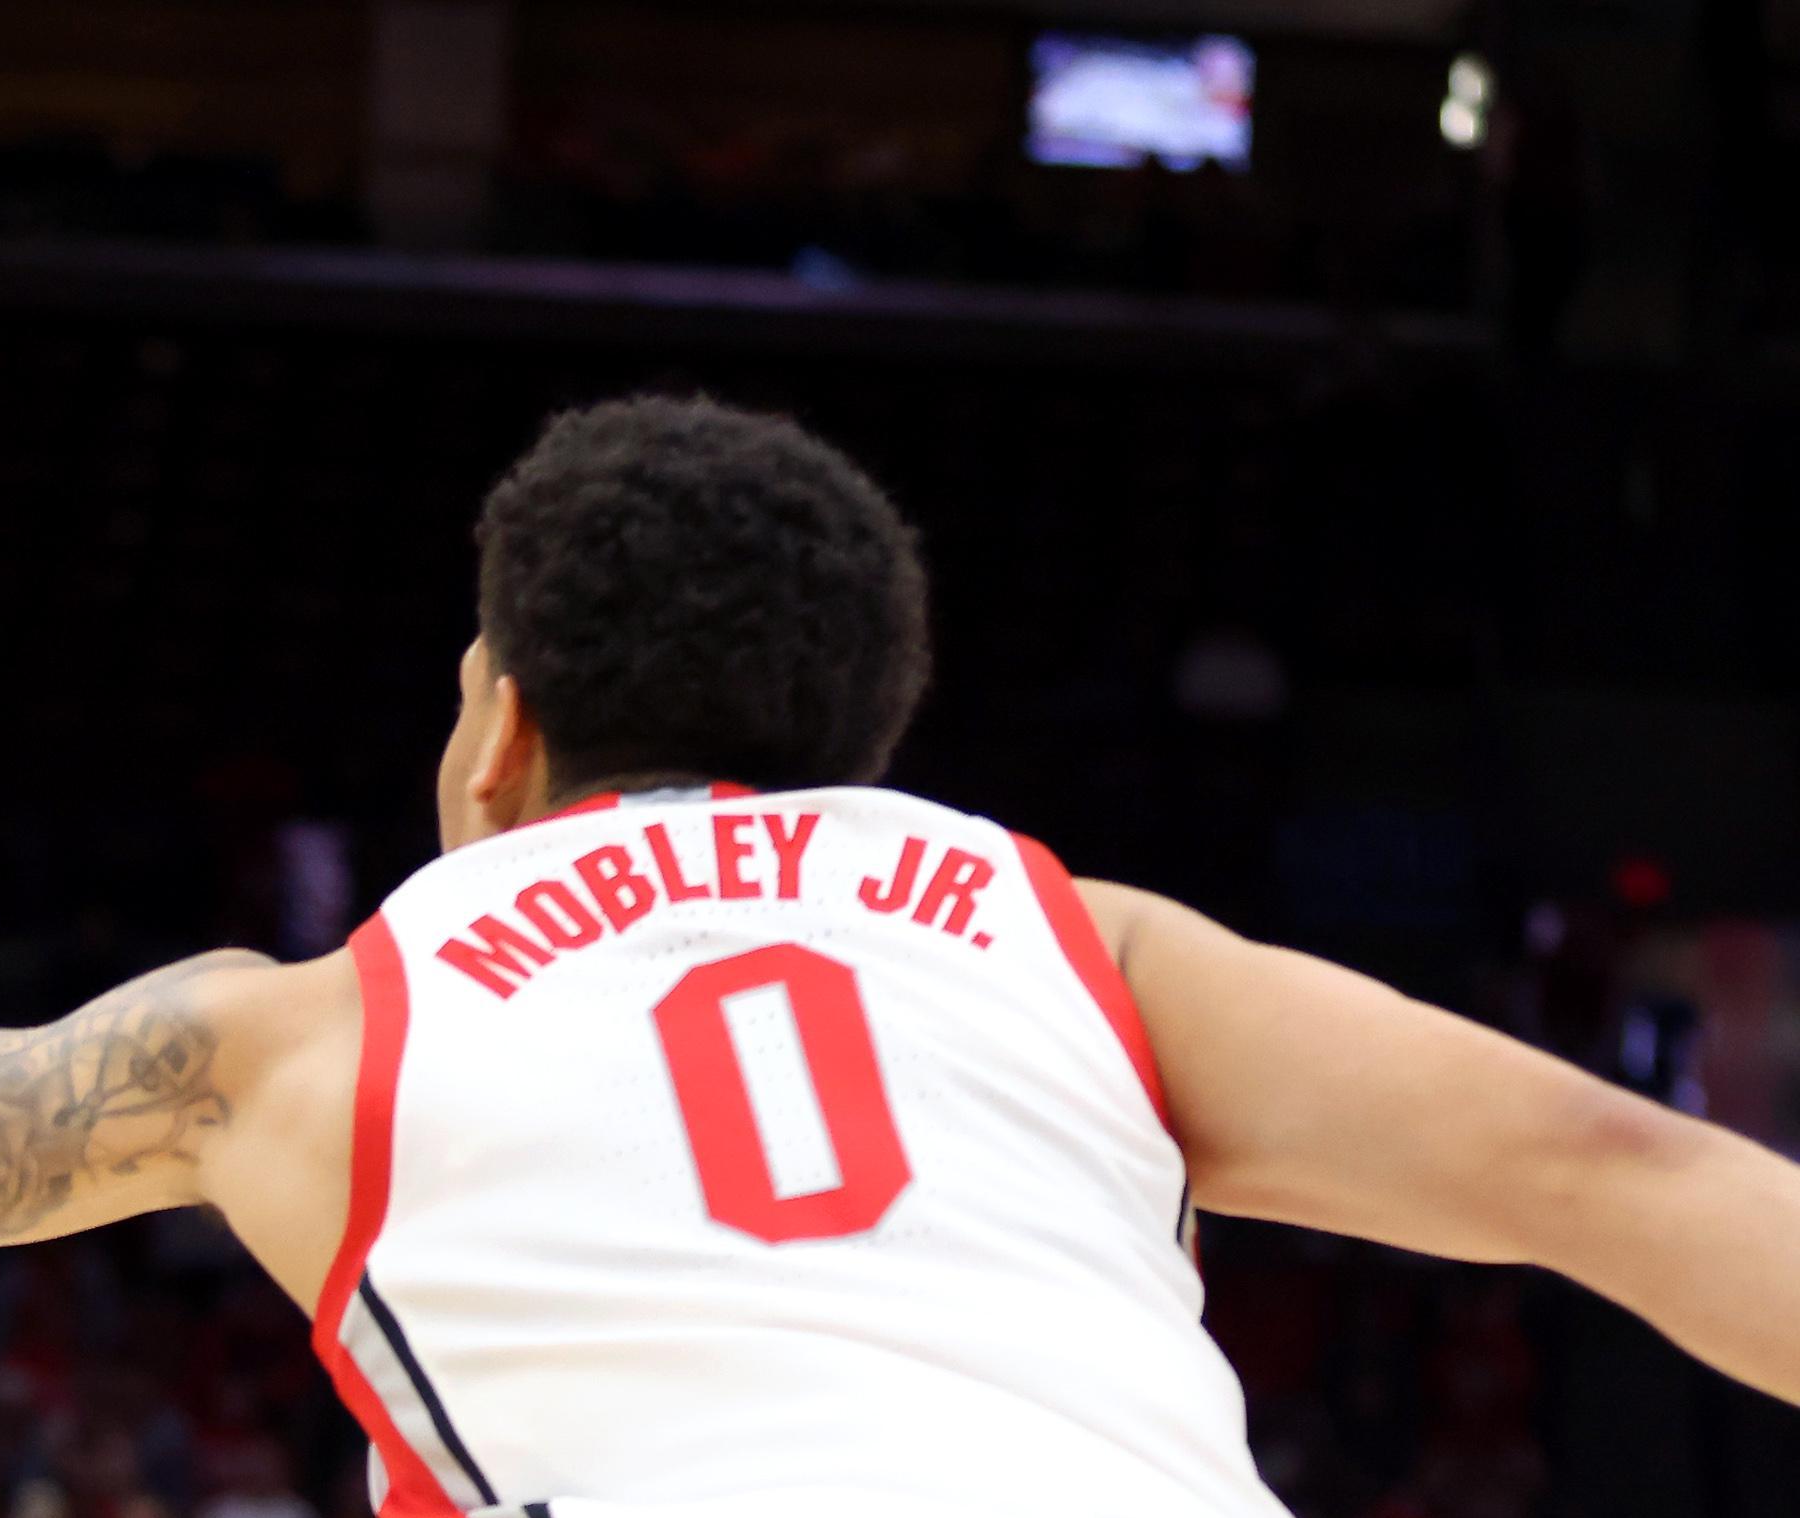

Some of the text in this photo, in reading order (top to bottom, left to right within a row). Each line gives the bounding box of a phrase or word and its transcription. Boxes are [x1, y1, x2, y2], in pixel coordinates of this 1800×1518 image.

[436, 814, 999, 1000] MOBLEY JR.
[651, 942, 913, 1245] 0
